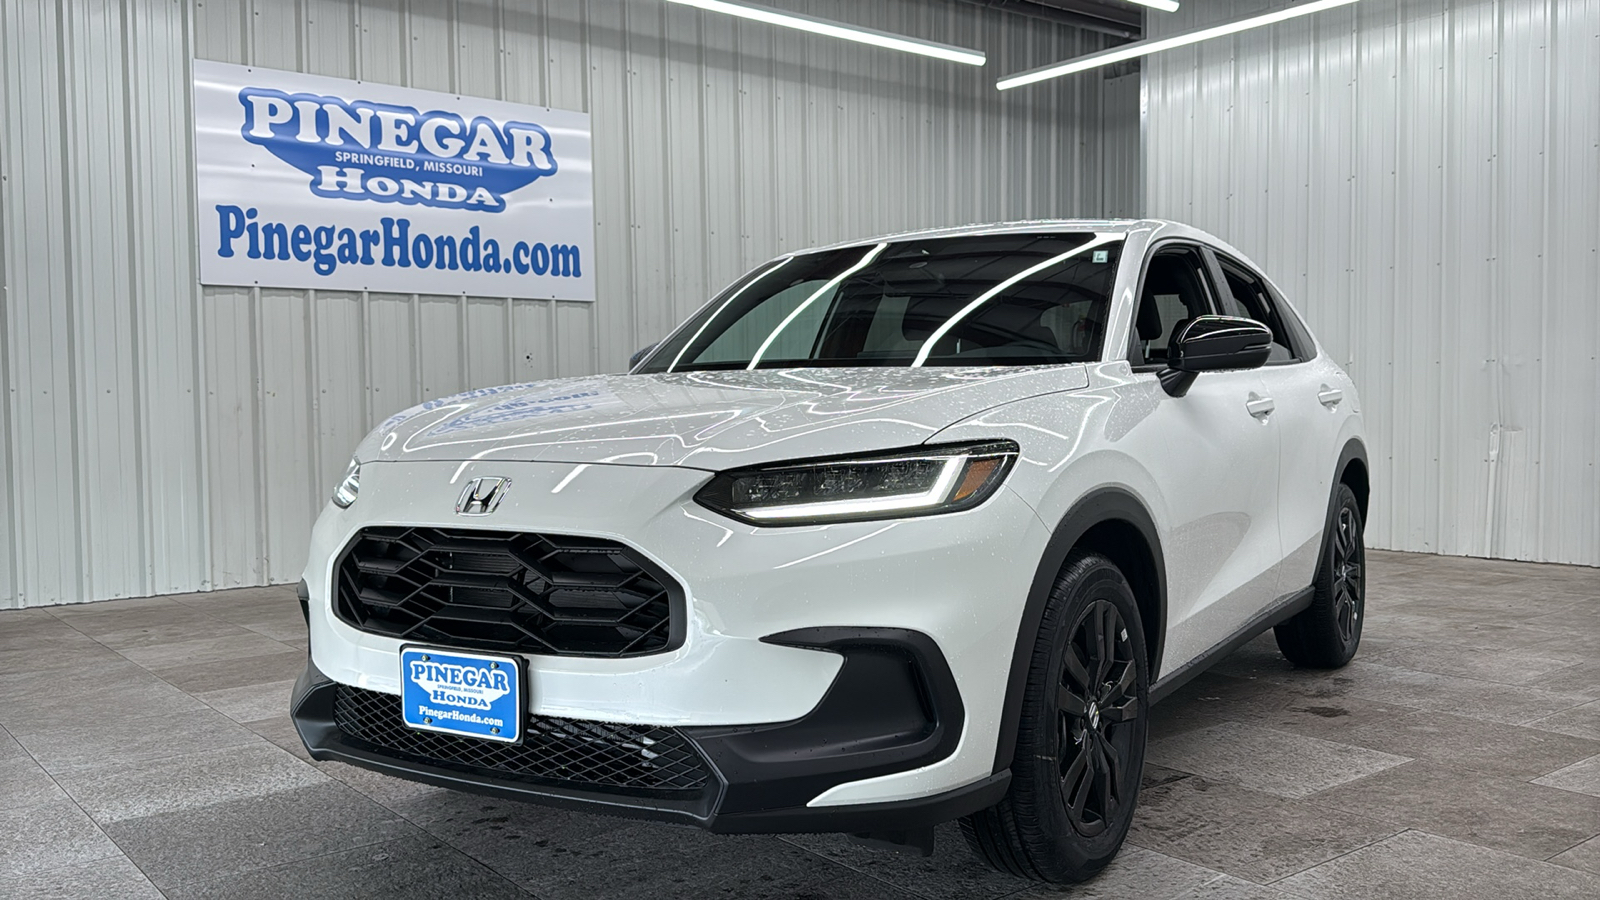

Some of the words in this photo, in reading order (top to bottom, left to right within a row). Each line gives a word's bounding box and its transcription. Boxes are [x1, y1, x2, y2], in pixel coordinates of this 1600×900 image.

[247, 95, 553, 170] PINEGAR
[335, 151, 420, 172] SPRINGFIELD,
[423, 161, 483, 177] MISSOURI
[317, 166, 500, 206] HONDA
[215, 205, 582, 277] PinegarHonda.com
[412, 663, 507, 691] PINEGAR
[432, 690, 489, 707] HONDA
[464, 687, 484, 695] MISSOURI
[418, 705, 503, 727] PinegarHonda.com
